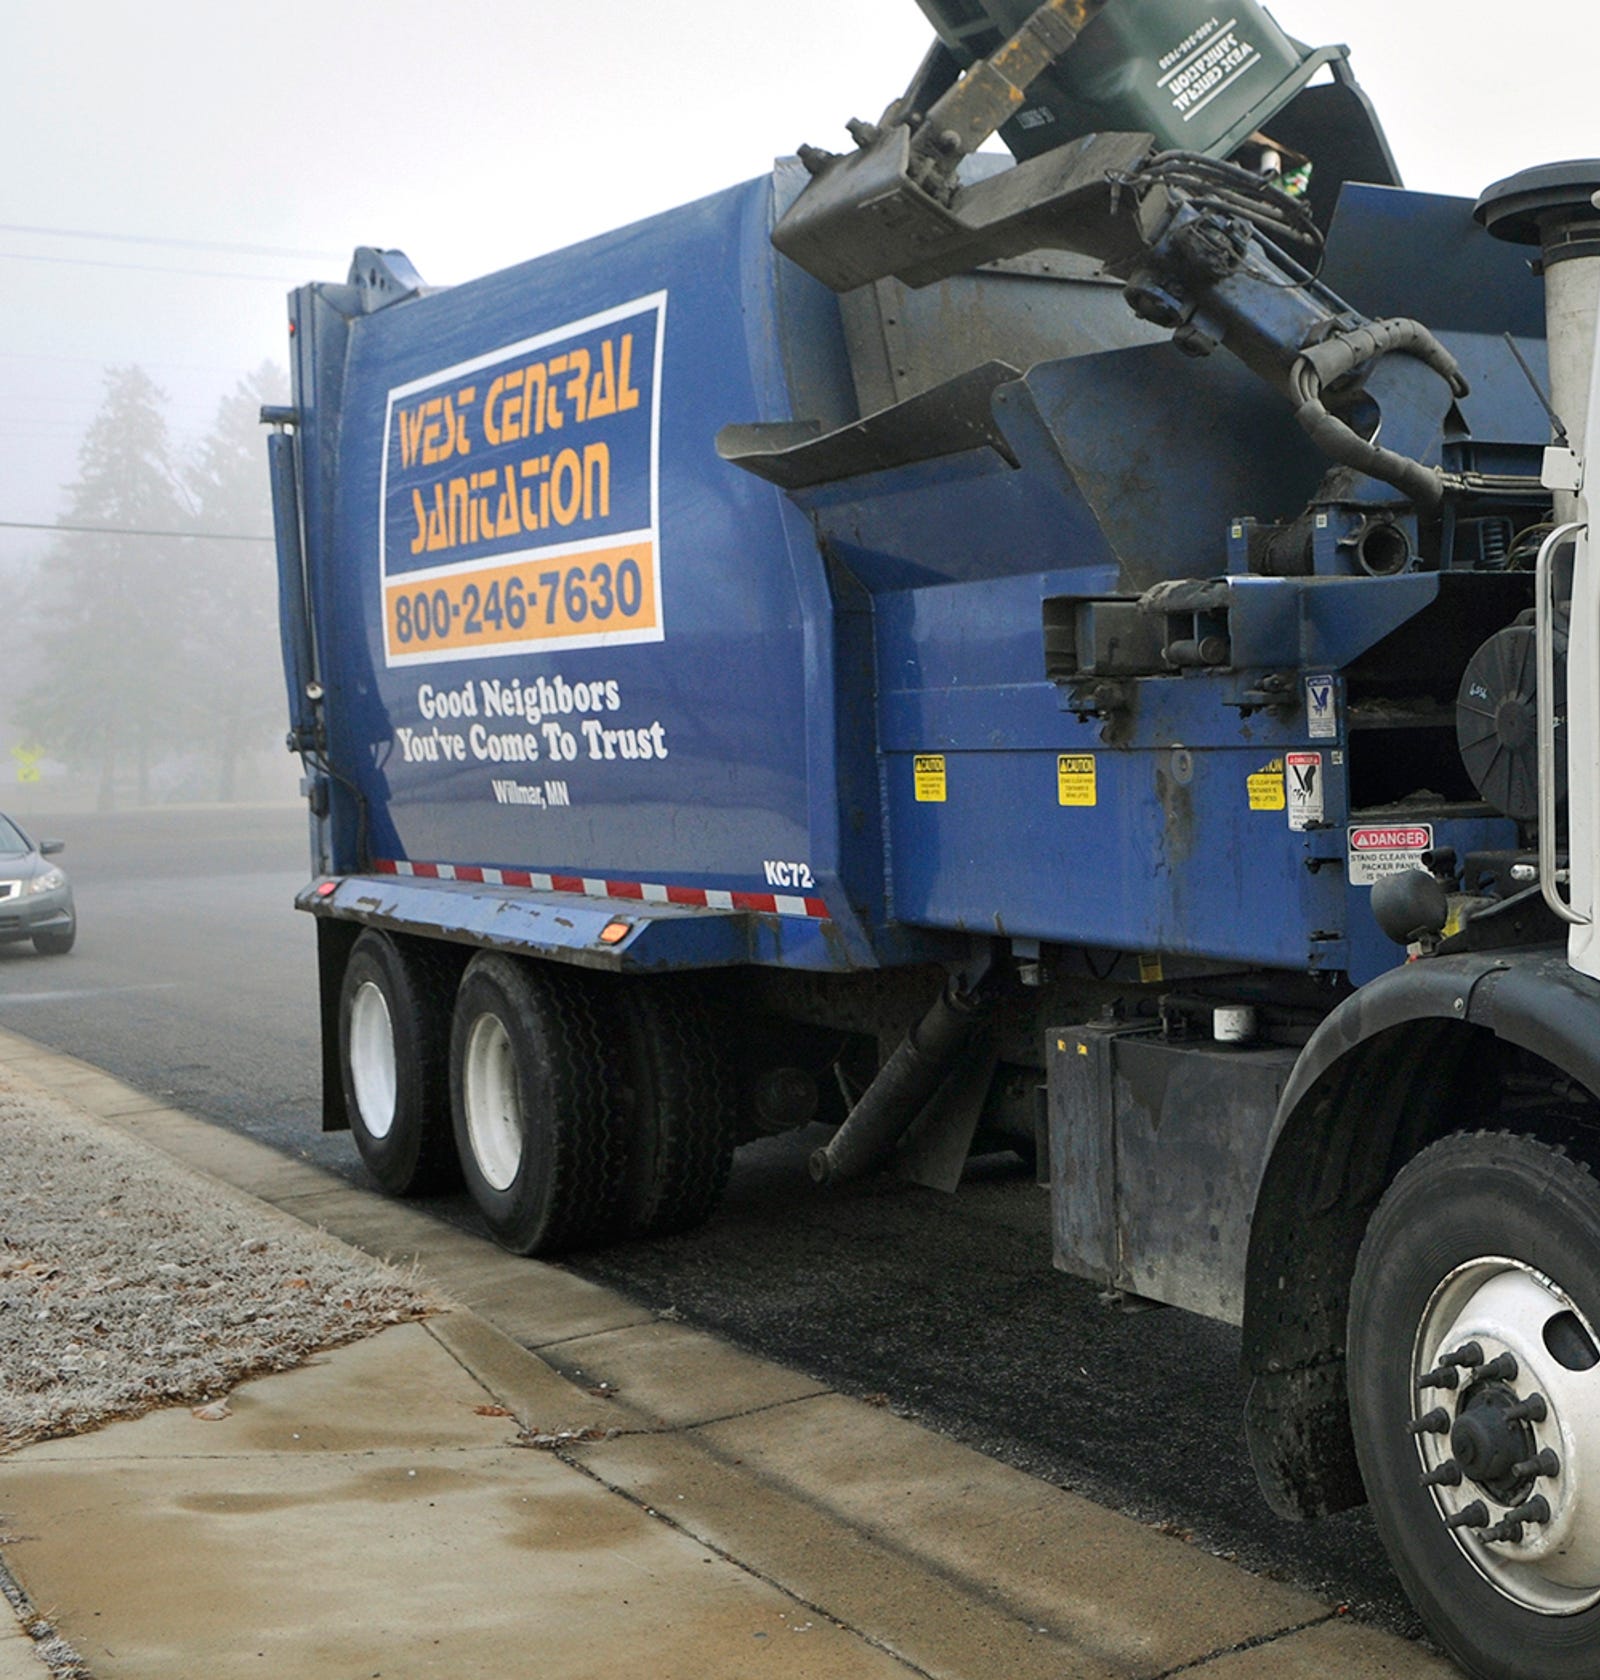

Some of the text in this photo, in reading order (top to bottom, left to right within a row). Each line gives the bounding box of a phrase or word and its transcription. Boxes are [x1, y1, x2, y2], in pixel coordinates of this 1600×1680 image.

[1168, 32, 1238, 96] SANITATION
[1171, 41, 1254, 112] WEST CENTRAL
[399, 333, 640, 469] WEST CENTRAL
[410, 441, 610, 555] SANITATION
[395, 557, 642, 645] 800-246-7630
[417, 675, 621, 726] Good Neighbors
[396, 720, 667, 762] You've Come To Trust
[492, 779, 570, 809] Willmar, MN
[1369, 832, 1424, 846] DANGER
[1378, 853, 1406, 861] CLEAR
[1408, 852, 1421, 860] WH
[764, 861, 813, 887] KC72
[1361, 863, 1393, 871] PACKER
